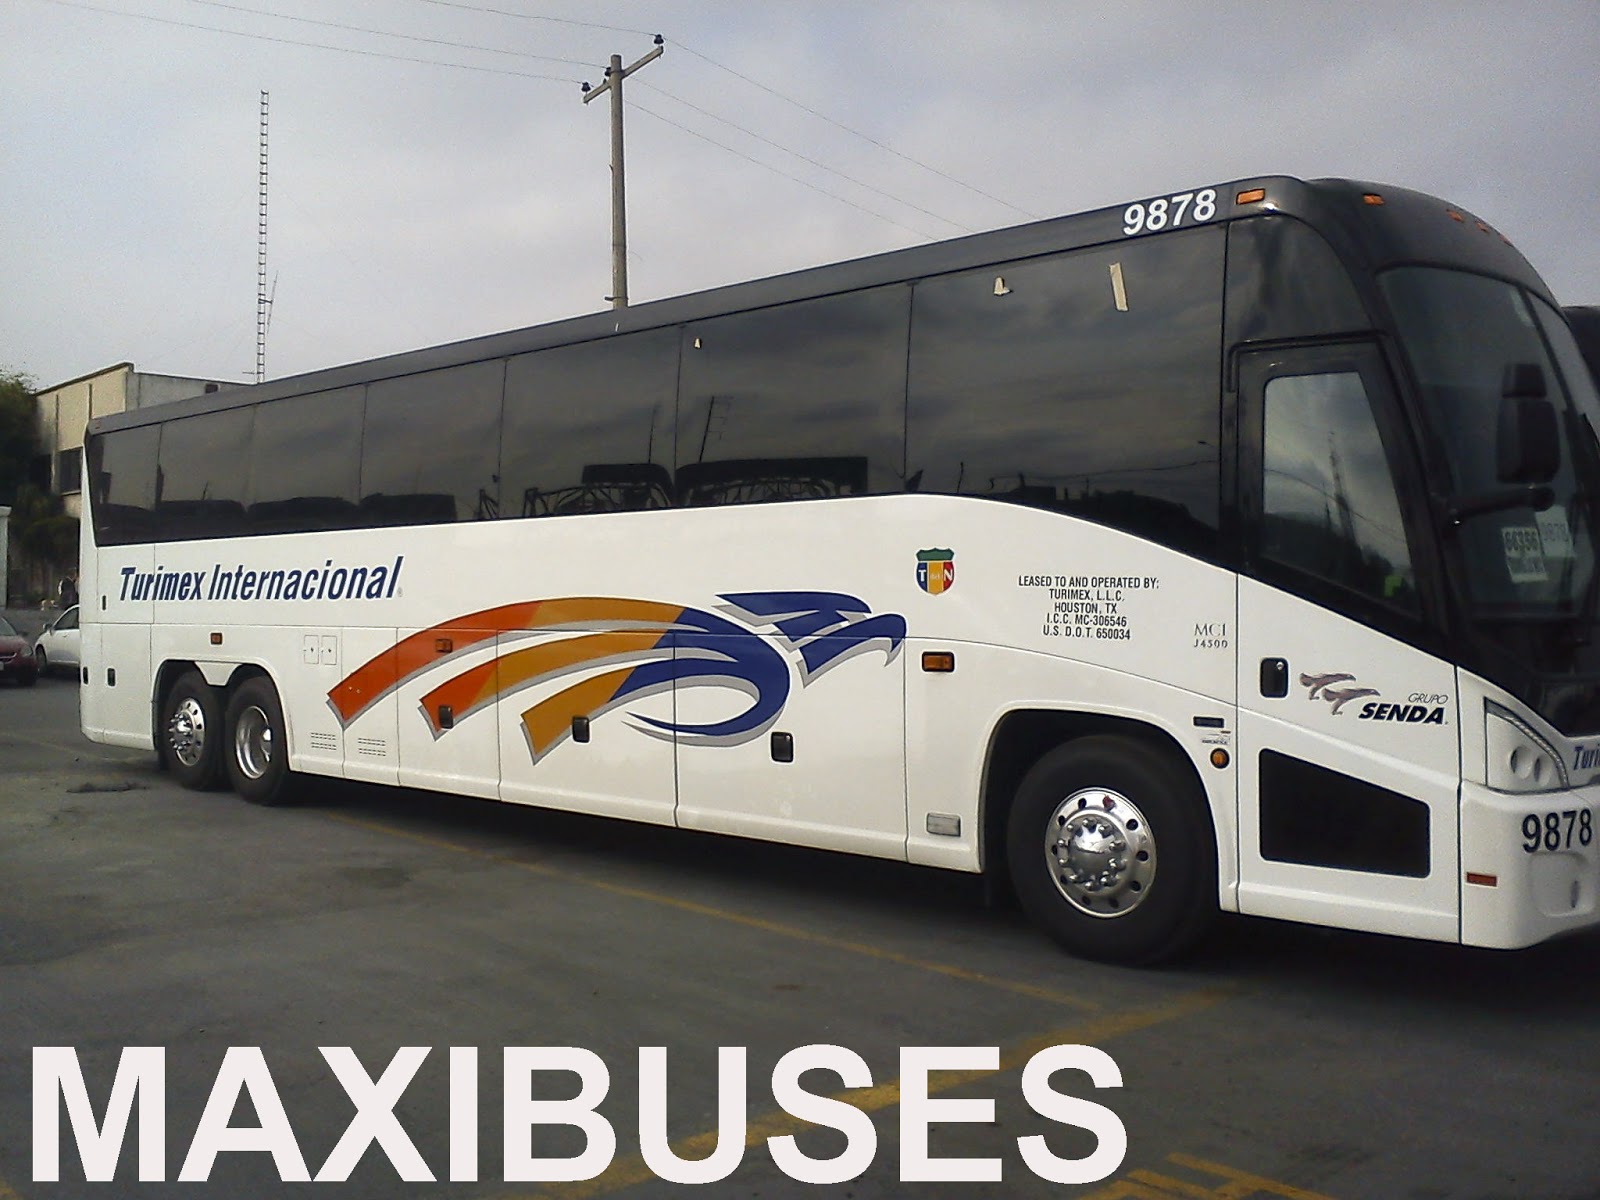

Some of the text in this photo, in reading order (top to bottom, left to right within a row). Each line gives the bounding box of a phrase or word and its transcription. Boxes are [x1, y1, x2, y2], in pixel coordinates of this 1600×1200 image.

[1123, 189, 1217, 236] 9878
[120, 556, 404, 601] Turimex Internacional
[1018, 575, 1160, 589] LEASED TO AND OPERATED BY:
[1049, 588, 1125, 602] TURIMEX, L.L.C.
[1054, 602, 1117, 614] HOUSTON, TX
[1046, 613, 1127, 627] I.C.C. MC-306546
[1043, 625, 1062, 636] U.S.
[1096, 628, 1131, 640] 650034
[1194, 623, 1226, 637] MCI
[1194, 638, 1228, 649] J4500
[1408, 692, 1449, 705] GRUPO
[1358, 702, 1445, 725] SENDA
[1522, 808, 1592, 853] 9878
